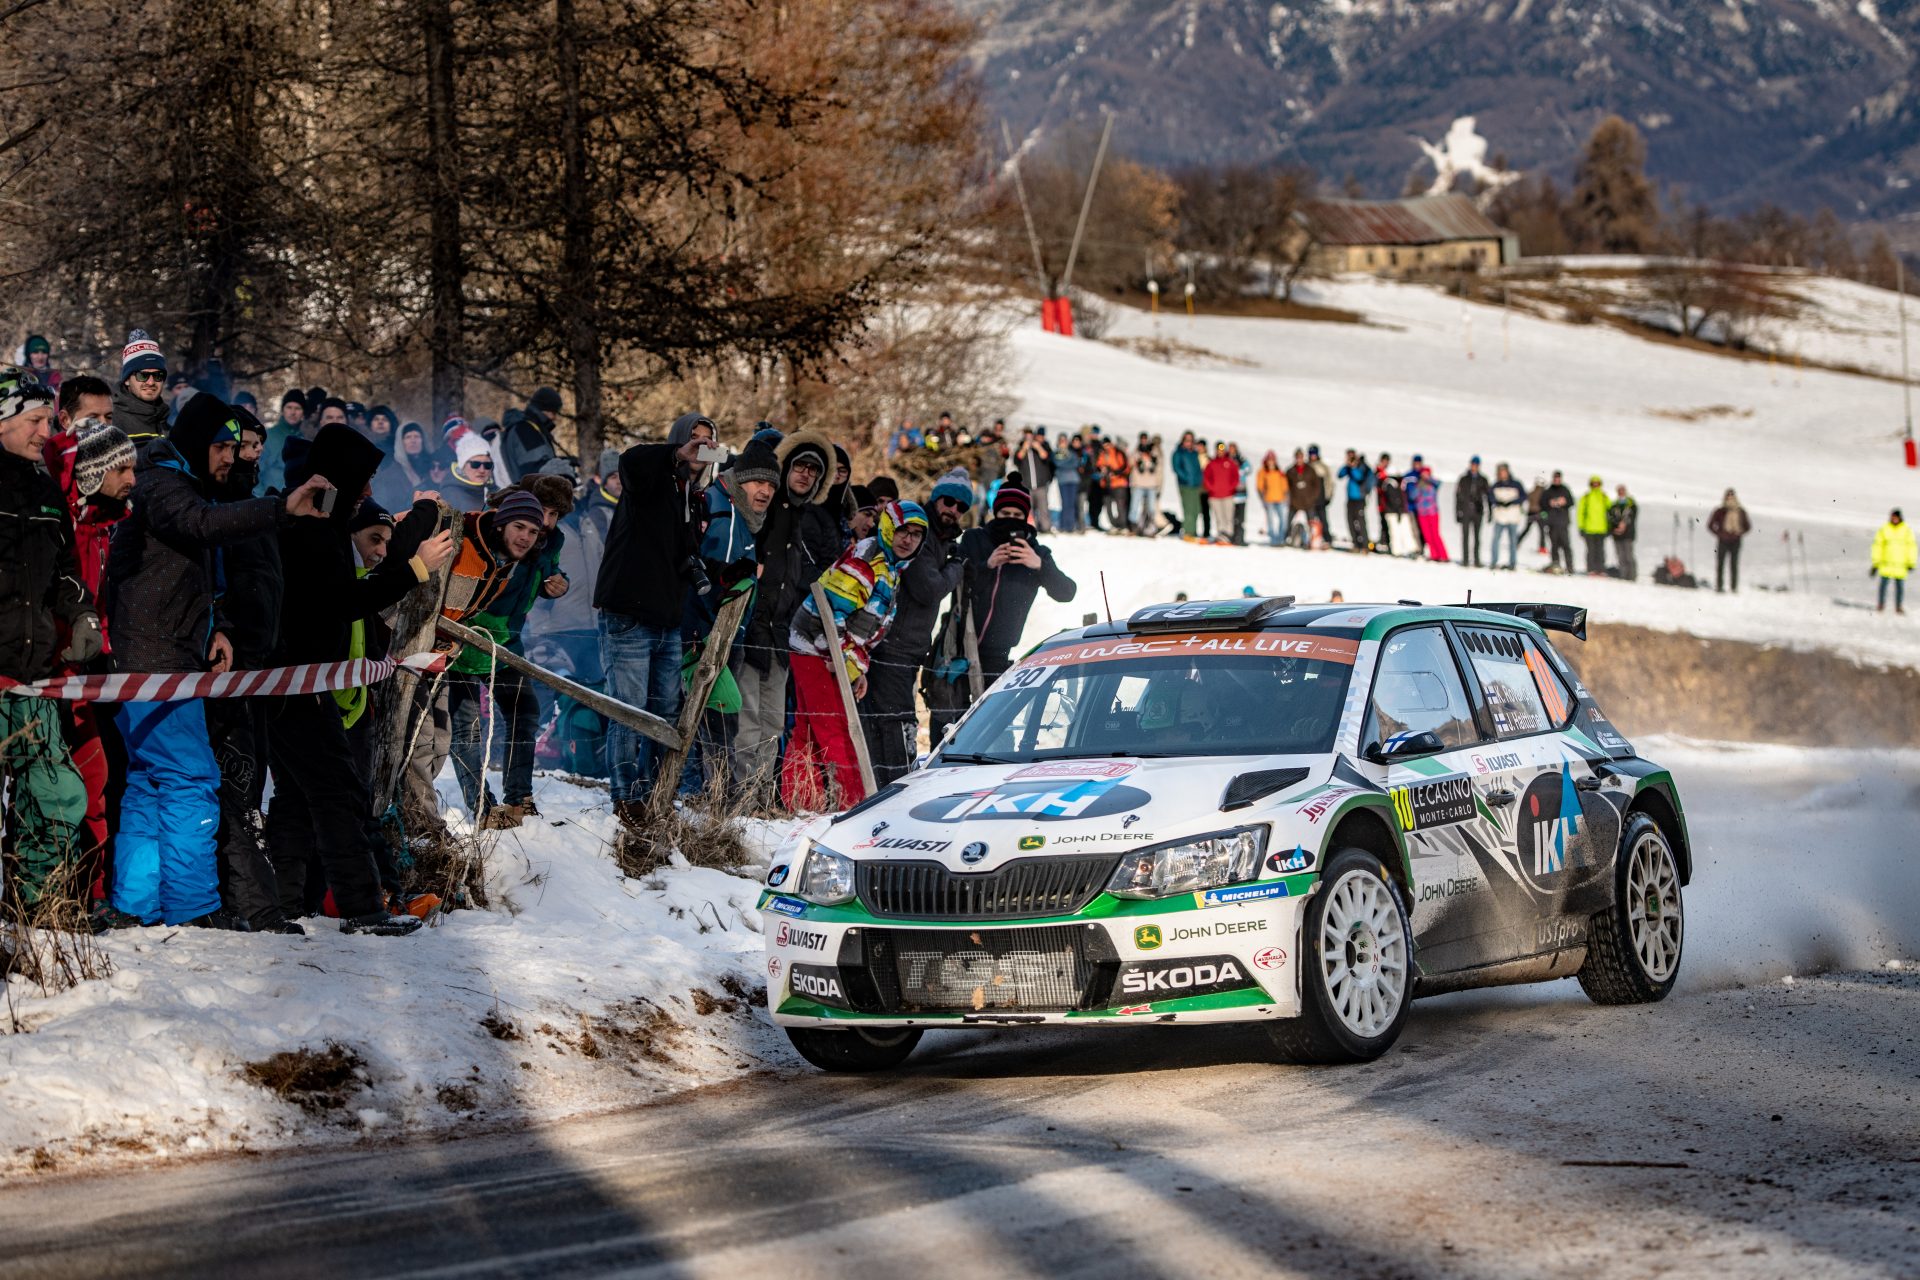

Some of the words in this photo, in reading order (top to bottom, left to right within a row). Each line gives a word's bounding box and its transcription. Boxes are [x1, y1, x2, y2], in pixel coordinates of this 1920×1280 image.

[1200, 638, 1247, 651] ALL
[1254, 639, 1313, 653] LIVE
[1049, 653, 1073, 663] PRO
[1003, 666, 1043, 690] 30
[1410, 784, 1426, 808] LE
[1426, 777, 1471, 806] CASINO
[866, 836, 952, 853] SILVASTI
[1052, 835, 1096, 845] JOHN
[1100, 832, 1154, 842] DEERE
[1221, 887, 1280, 902] MICHELIN
[1419, 882, 1445, 902] JOHN
[1447, 877, 1478, 897] DEERE
[781, 925, 828, 951] SILVASTI
[1169, 926, 1211, 941] JOHN
[1215, 919, 1268, 936] DEERE
[792, 969, 842, 998] ŠKODA
[1122, 962, 1243, 994] ŠKODA
